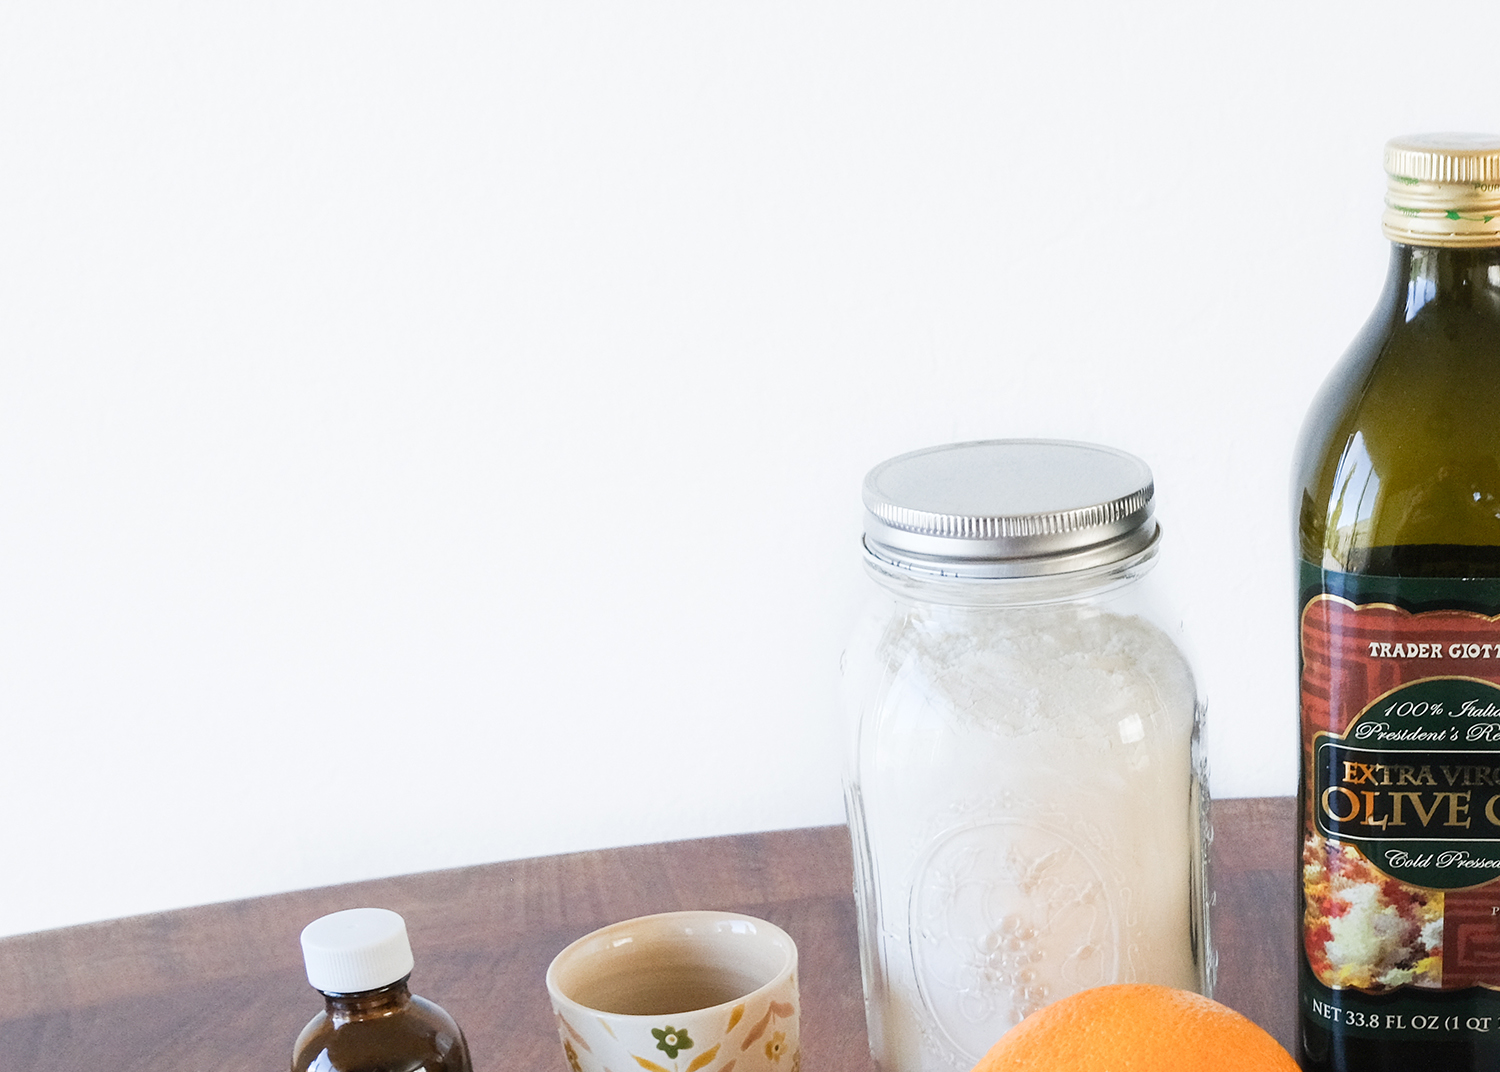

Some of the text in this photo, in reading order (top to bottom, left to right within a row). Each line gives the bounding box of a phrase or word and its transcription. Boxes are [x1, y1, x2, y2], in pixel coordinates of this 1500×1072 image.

[1368, 642, 1442, 658] TRADER
[1384, 701, 1444, 718] 100%
[1354, 721, 1459, 742] President's
[1342, 761, 1438, 786] EXTRA
[1321, 786, 1472, 830] OLIVE
[1384, 850, 1430, 870] Cold
[1312, 998, 1342, 1023] NET
[1346, 1010, 1380, 1028] 33.8
[1385, 1014, 1406, 1030] FL
[1411, 1015, 1440, 1030] OZ
[1444, 1016, 1460, 1032] (1
[1466, 1017, 1492, 1032] QT
